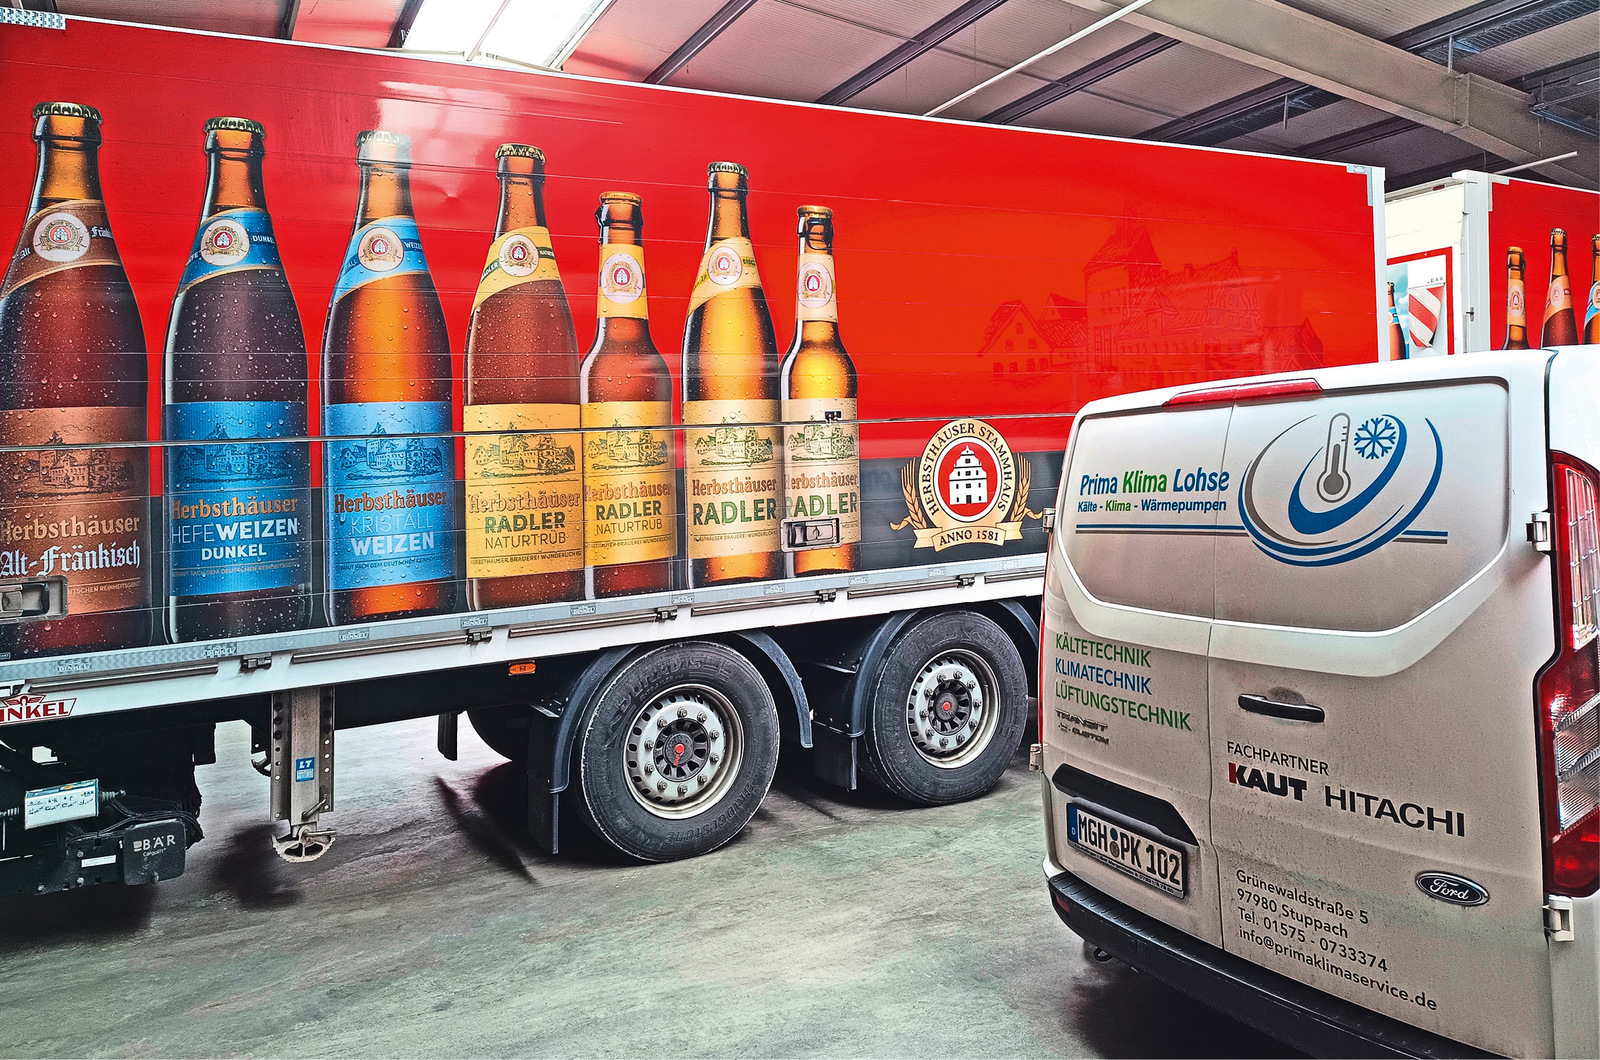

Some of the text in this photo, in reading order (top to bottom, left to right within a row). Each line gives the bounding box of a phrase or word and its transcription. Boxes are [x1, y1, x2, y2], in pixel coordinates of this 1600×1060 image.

[785, 471, 858, 490] Herbsthäuser
[922, 423, 1012, 516] HERBSTHÄUSER STAMMHAUS
[1080, 467, 1230, 496] Prima Klima Lohse
[584, 480, 672, 502] Herbsthäuser
[692, 476, 777, 496] Herbsthäuser
[171, 495, 298, 520] Herbsthäuser
[334, 489, 447, 514] Herbsthäuser
[468, 490, 580, 514] Herbsthäuser
[595, 500, 662, 521] RADLER
[693, 497, 777, 526] RADLER
[785, 491, 858, 518] RADLER
[1077, 501, 1097, 513] Kälte
[1105, 500, 1131, 512] Klima
[1141, 499, 1227, 514] Wärmepumpen
[351, 510, 434, 535] KRISTALL
[485, 511, 566, 534] RADLER
[596, 516, 663, 535] NATURTRÜB
[350, 531, 435, 557] WEIZEN
[485, 530, 568, 550] NATURTRÜB
[939, 530, 999, 546] ANNO 1581
[0, 539, 140, 577] Alt-Fränkisch
[201, 543, 267, 561] DUNKEL
[1055, 632, 1152, 668] KÄLTETECHNIK
[1055, 657, 1152, 696] KLIMATECHNIK
[0, 702, 69, 722] INKEL
[1055, 680, 1193, 732] LÜFTUNGSTECHNIK
[1227, 741, 1329, 776] FACHPARTNER
[1228, 762, 1465, 837] KAUT HITACHI
[143, 834, 176, 851] BÄR
[1078, 814, 1108, 853] MGH
[1119, 831, 1142, 868] PK
[1145, 844, 1180, 886] 102
[1236, 869, 1369, 924] Grünewaldstraße 5
[1429, 877, 1469, 901] Ford
[1236, 888, 1349, 939] 97980 Stuppach
[1238, 906, 1259, 926] Tel.
[1263, 916, 1306, 943] 01575
[1319, 937, 1388, 972] 0733374
[1239, 926, 1437, 1011] info@primaklimaservice.de
